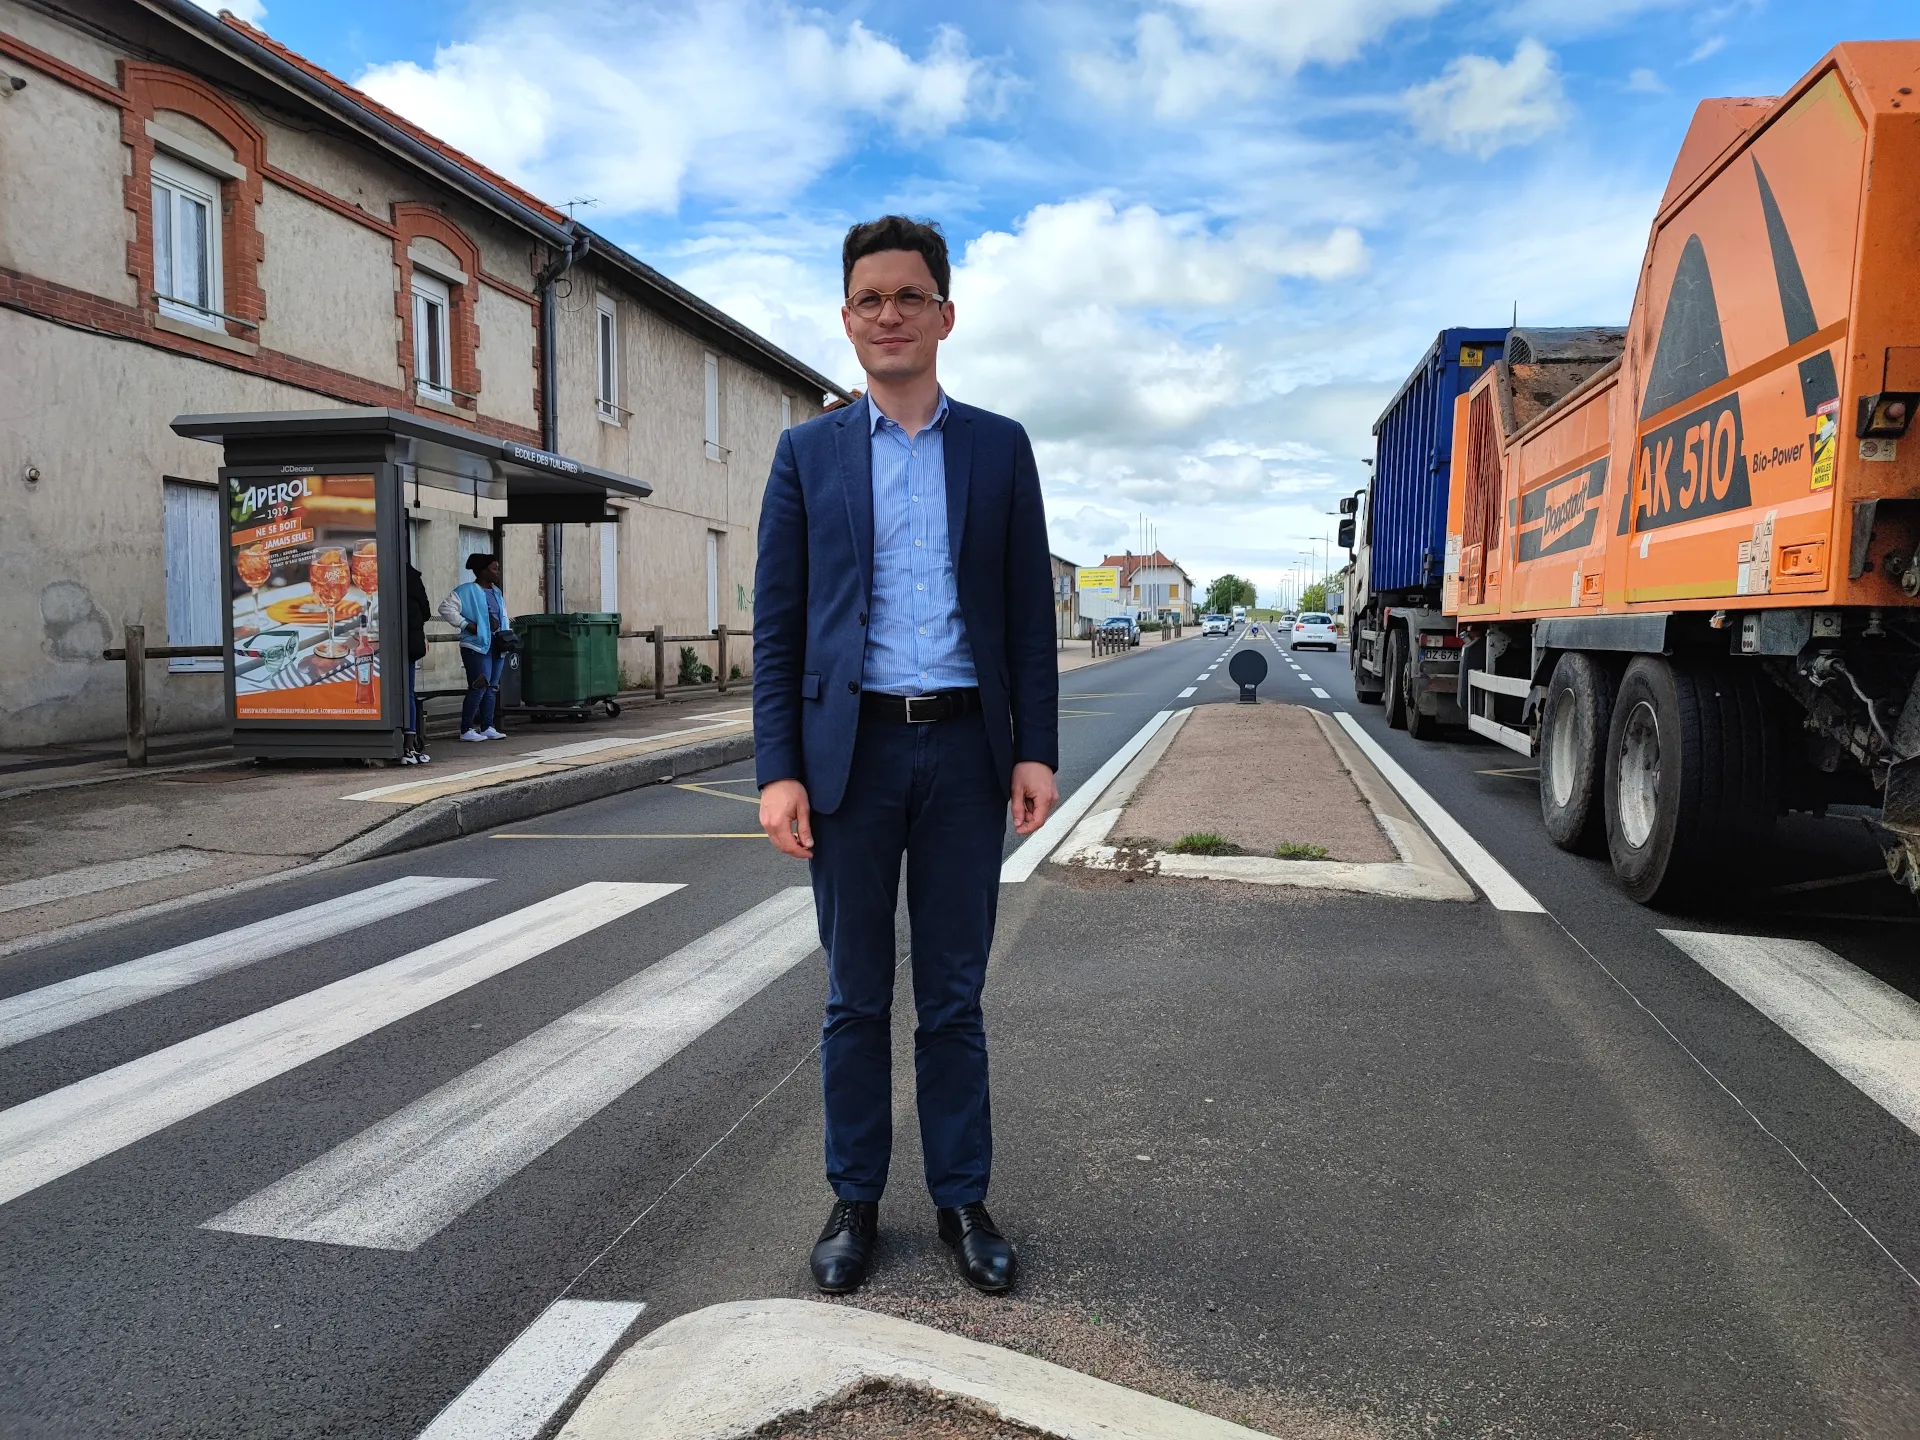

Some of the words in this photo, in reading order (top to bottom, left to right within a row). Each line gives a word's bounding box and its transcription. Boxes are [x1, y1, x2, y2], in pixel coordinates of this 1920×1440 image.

[514, 446, 536, 462] ECOLE
[536, 453, 549, 466] DES
[549, 457, 578, 474] TUILERIES
[1637, 436, 1673, 518] AK
[1679, 409, 1736, 510] 510
[1752, 443, 1805, 474] Bio-Power
[280, 465, 315, 473] JCDecaux
[1814, 462, 1832, 475] ANGLES
[1813, 473, 1830, 484] MORTS
[242, 477, 312, 515] APEROL
[267, 505, 289, 520] 1919
[255, 528, 266, 538] NE
[268, 525, 277, 534] SE
[279, 519, 297, 531] BOIT
[264, 535, 291, 549] JAMAIS
